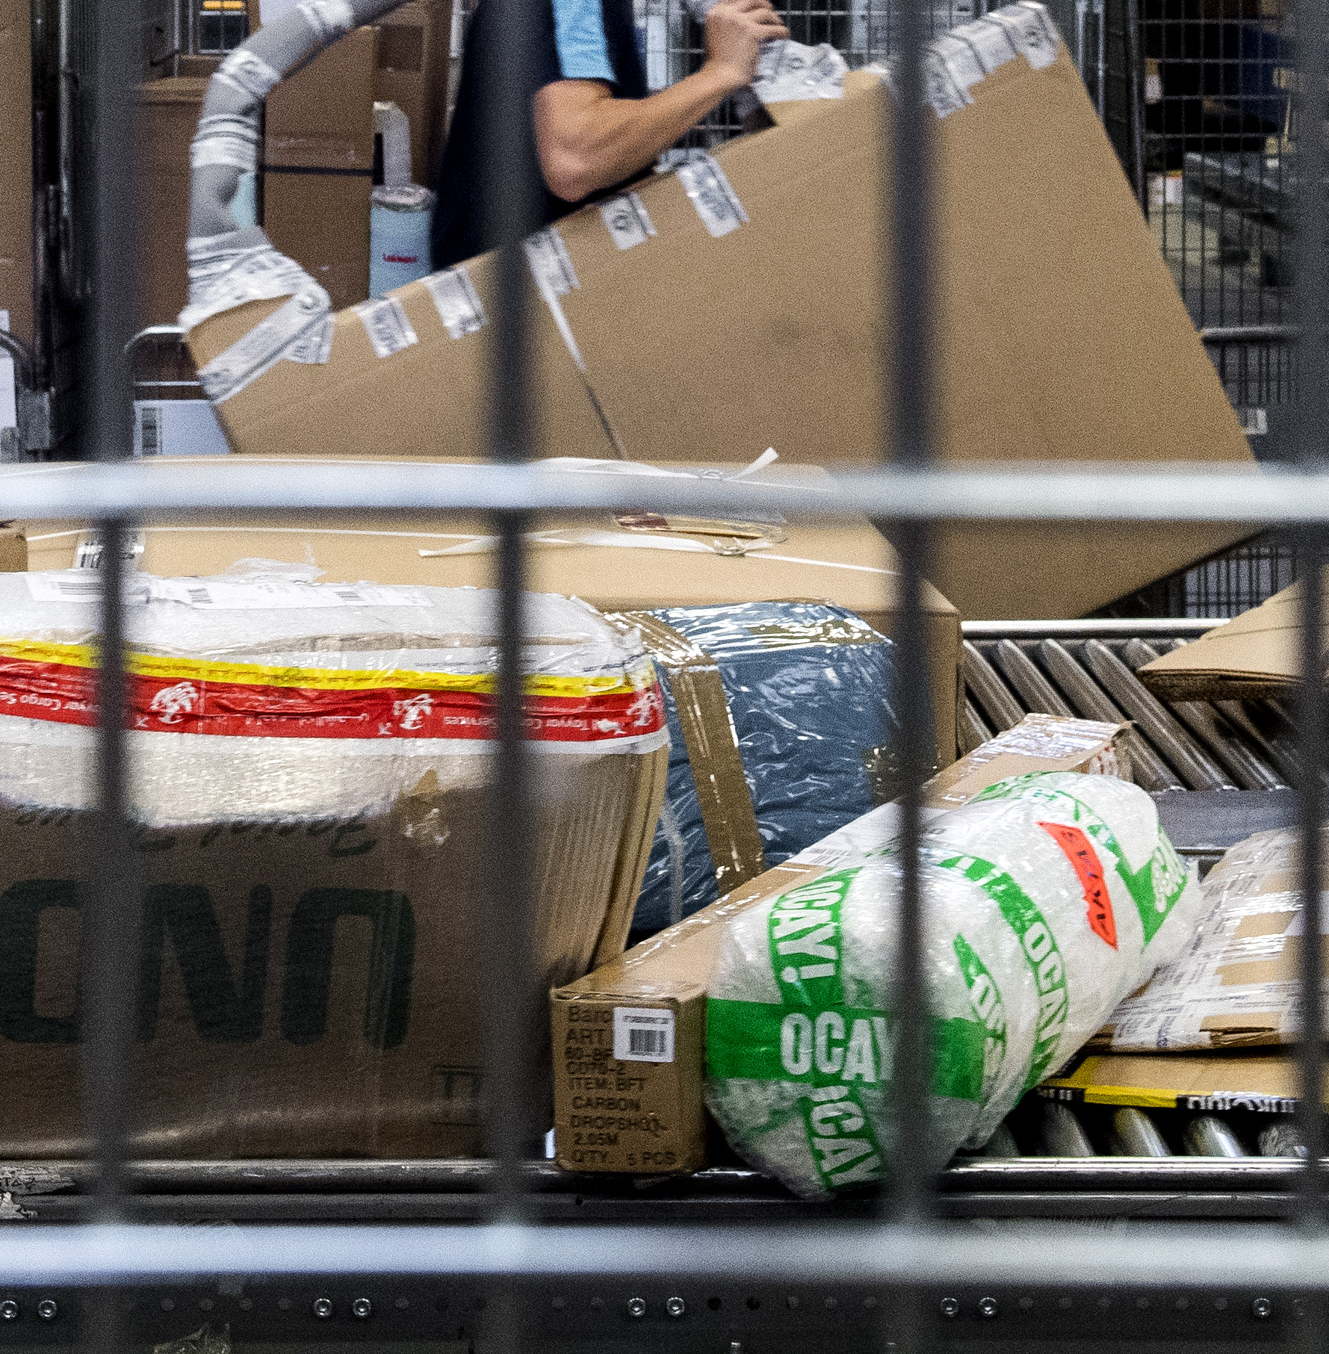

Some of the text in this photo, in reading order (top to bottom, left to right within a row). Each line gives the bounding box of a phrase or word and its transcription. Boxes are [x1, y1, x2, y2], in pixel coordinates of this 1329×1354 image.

[20, 692, 62, 711] Cargo
[572, 1095, 641, 1112] CARBON
[641, 1150, 677, 1166] PCS
